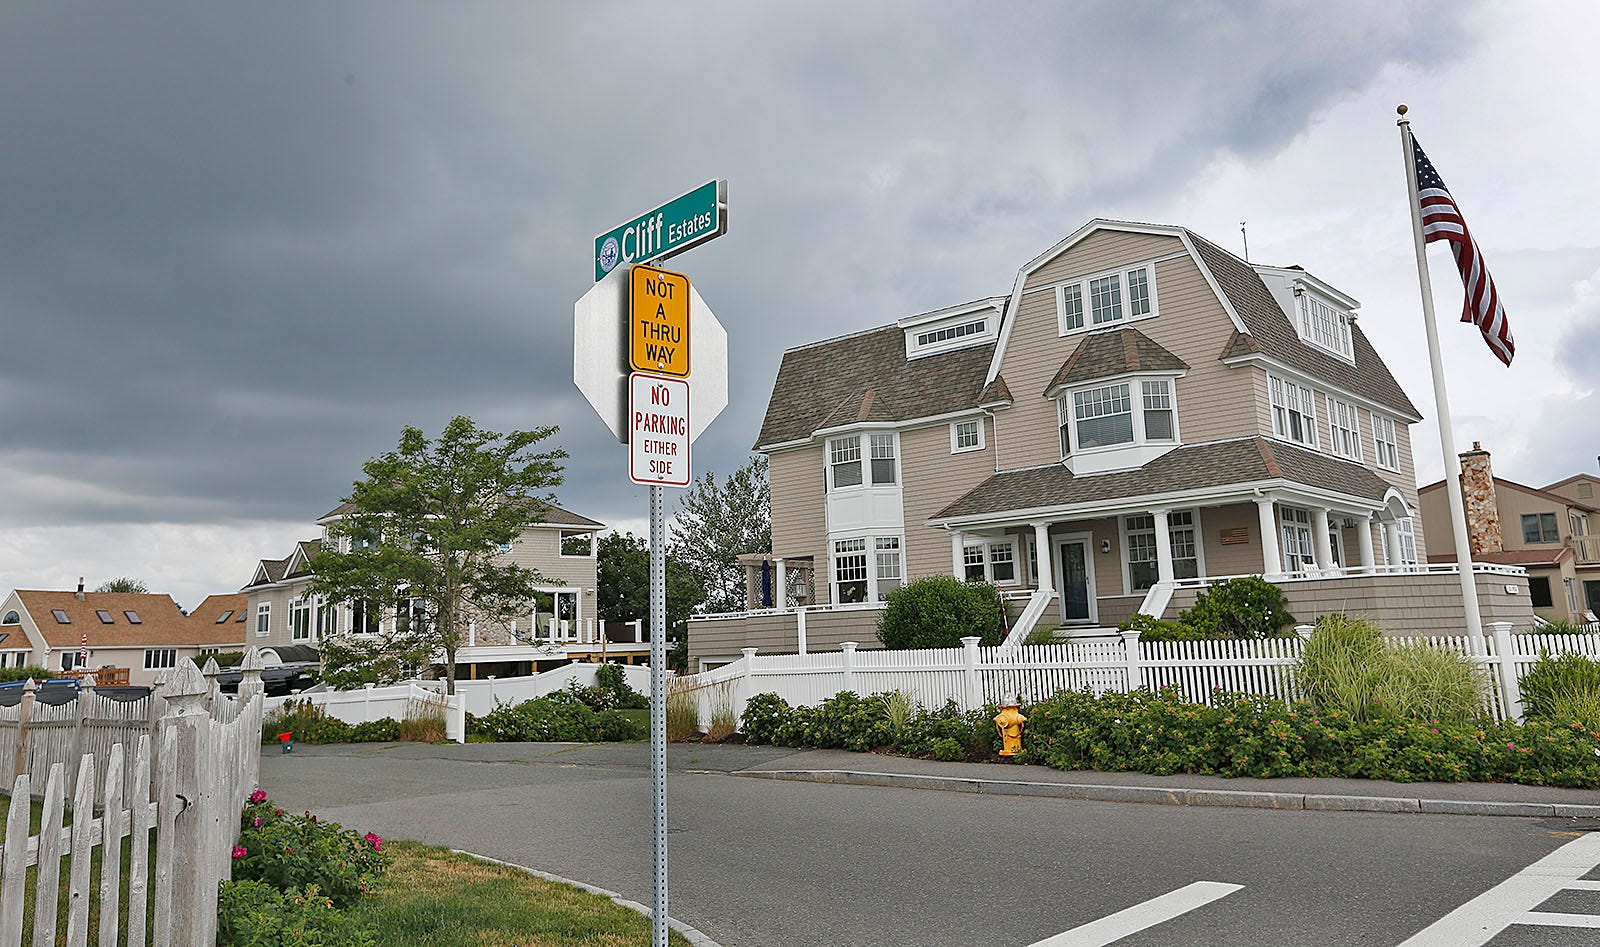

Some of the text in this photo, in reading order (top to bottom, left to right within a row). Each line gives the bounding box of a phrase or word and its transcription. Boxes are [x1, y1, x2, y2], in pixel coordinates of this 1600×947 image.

[621, 211, 712, 264] Cliff Estates
[646, 278, 676, 300] NOT
[655, 302, 667, 321] A
[641, 320, 681, 344] THRU
[646, 343, 676, 365] WAY
[651, 385, 670, 407] NO
[635, 411, 686, 436] PARKING
[644, 439, 678, 456] EITHER
[649, 459, 673, 475] SIDE
